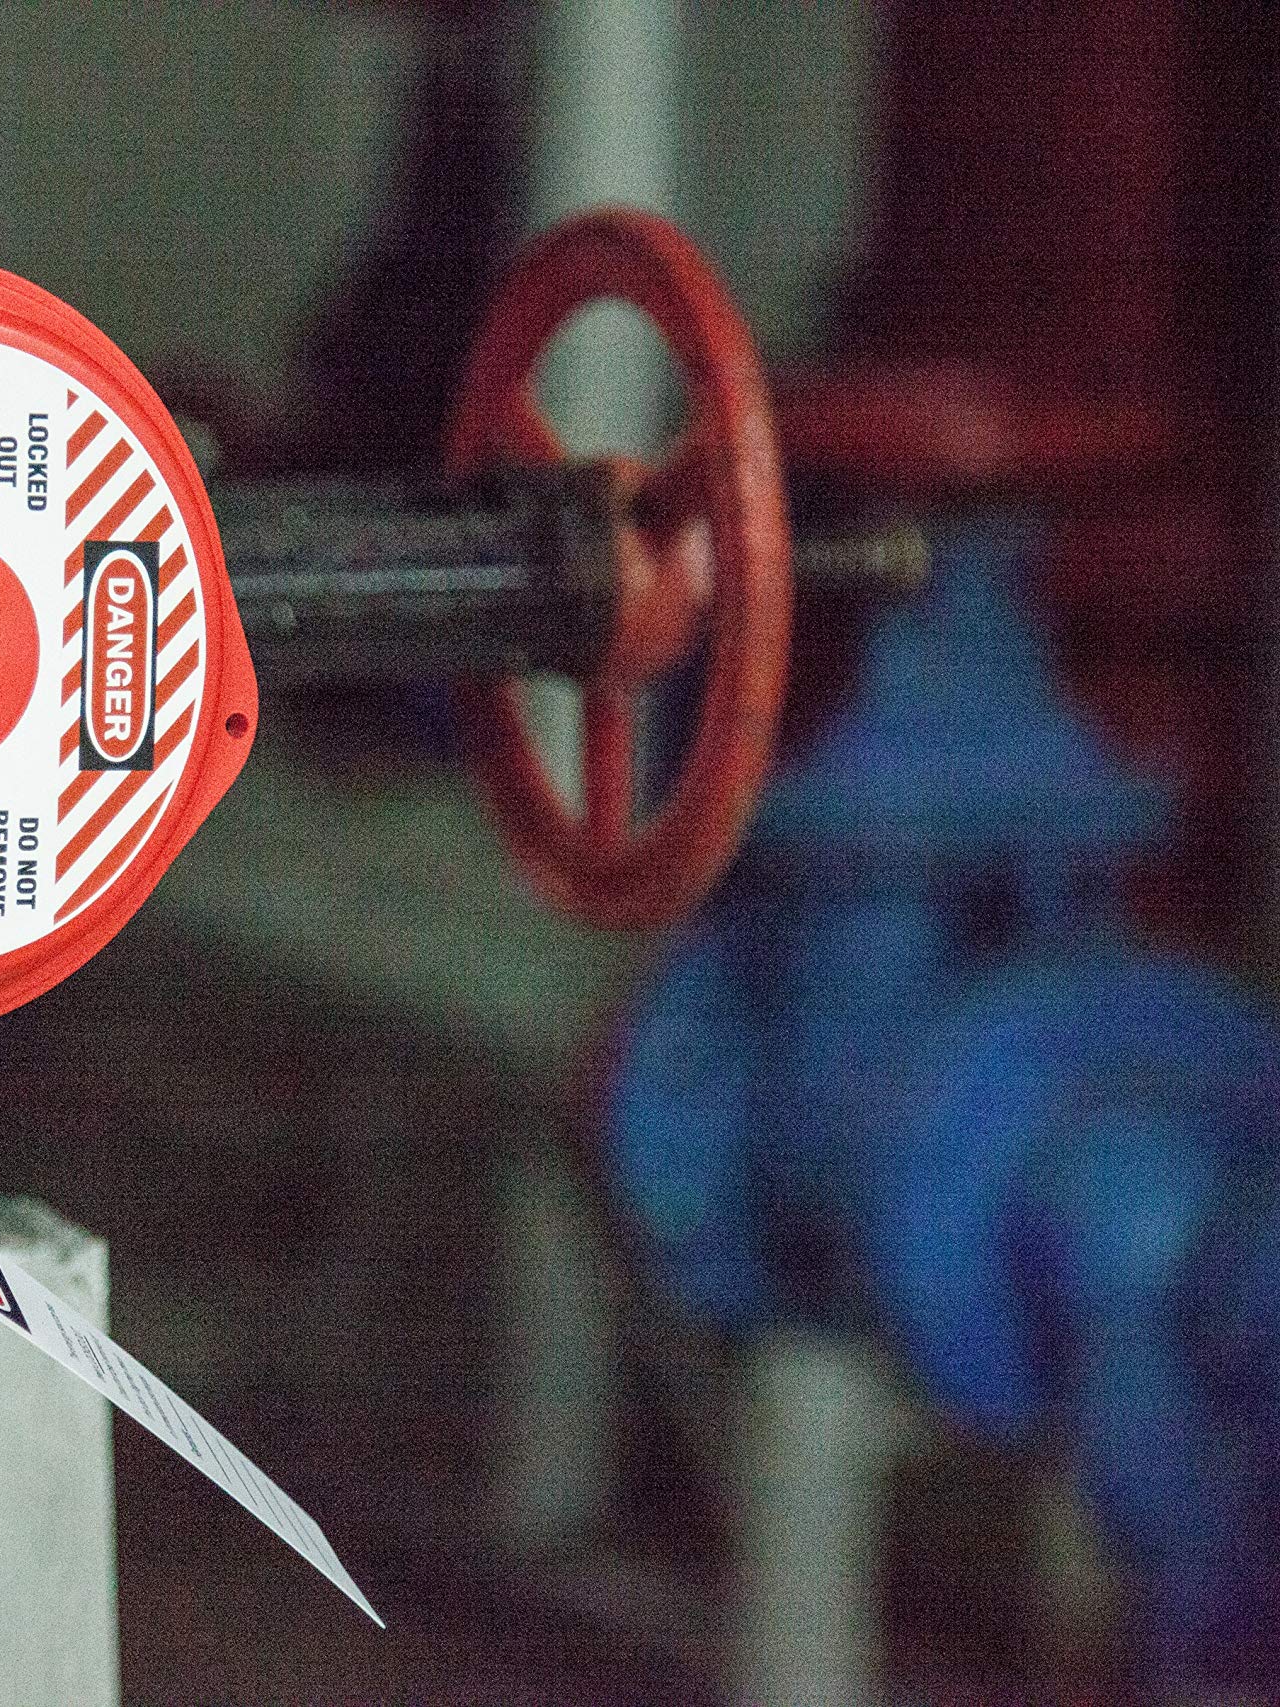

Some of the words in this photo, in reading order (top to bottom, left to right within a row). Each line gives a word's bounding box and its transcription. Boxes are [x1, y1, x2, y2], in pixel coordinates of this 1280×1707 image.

[27, 412, 49, 512] LOCKED
[103, 576, 136, 742] DANGER
[18, 817, 39, 852] DO
[16, 860, 38, 909] NOT
